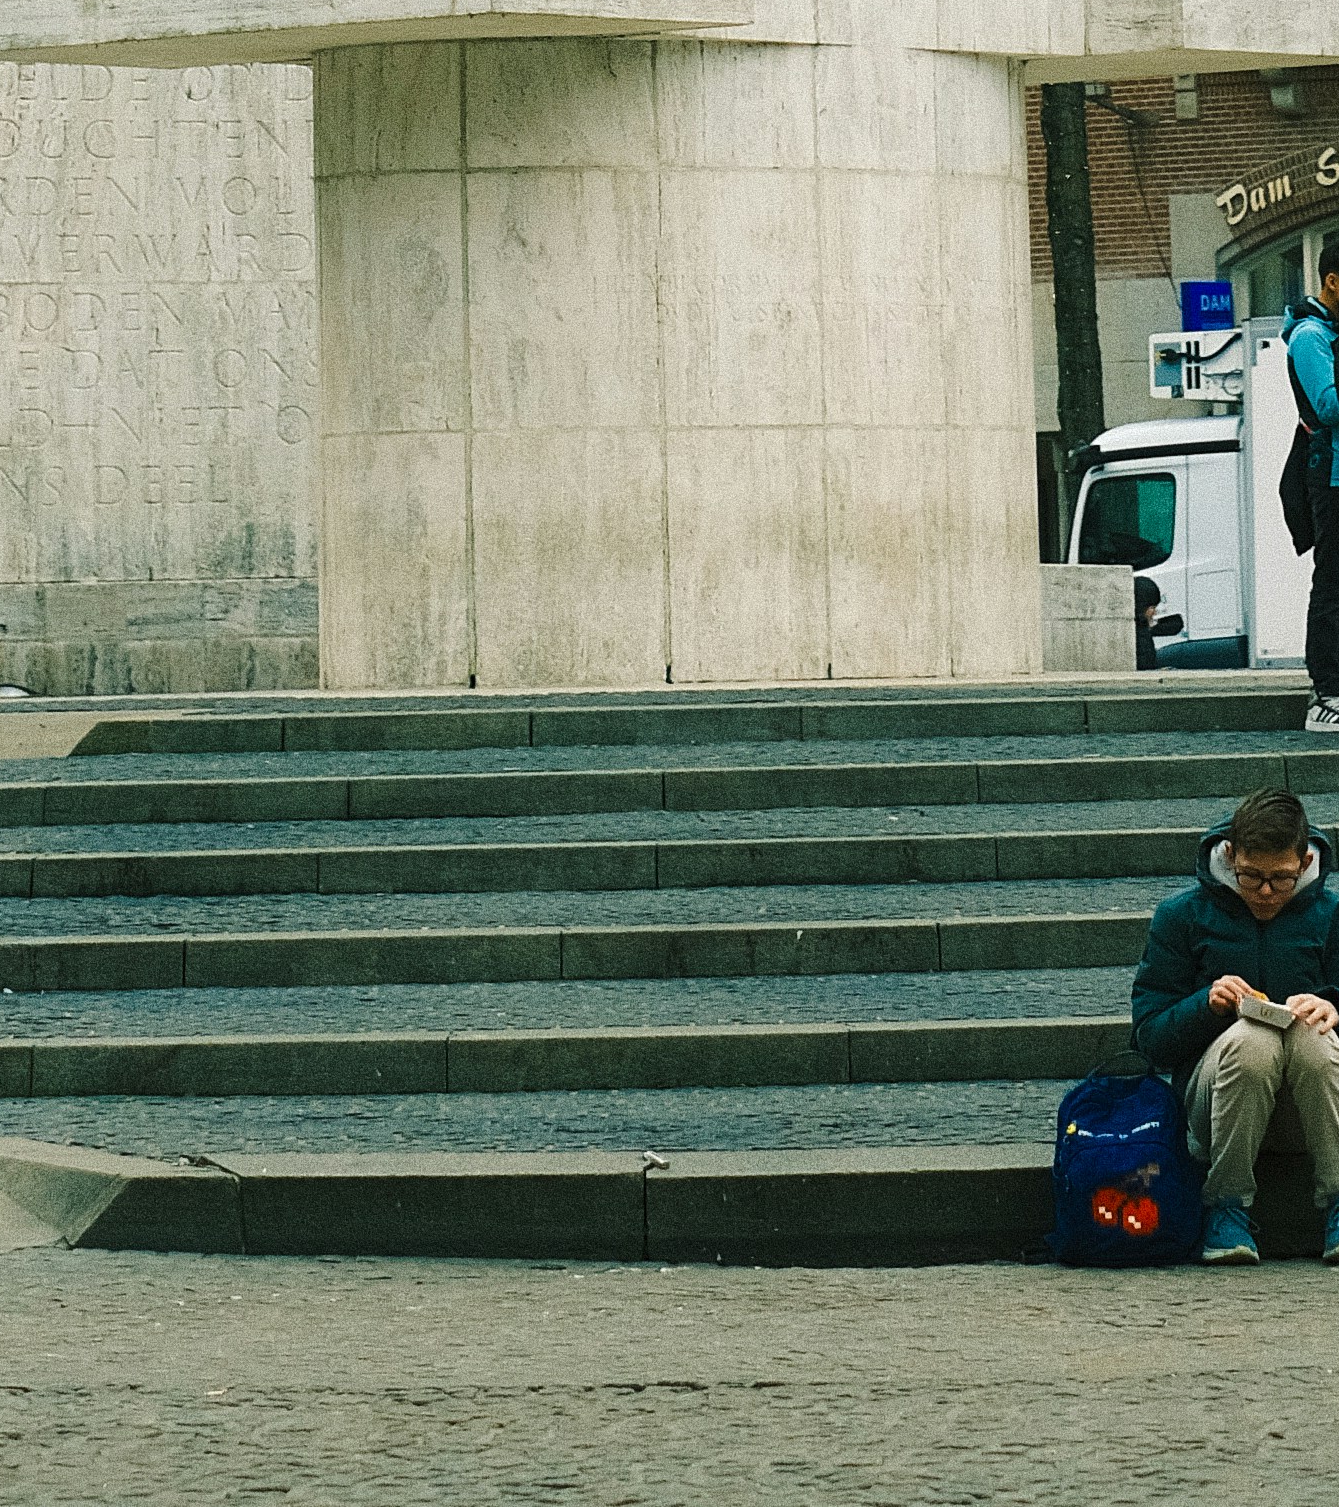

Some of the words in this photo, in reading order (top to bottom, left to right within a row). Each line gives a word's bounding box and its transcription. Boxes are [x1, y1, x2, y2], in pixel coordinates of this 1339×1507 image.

[1216, 172, 1294, 226] Dam
[13, 230, 315, 274] VERWARD
[93, 462, 231, 507] DEEL
